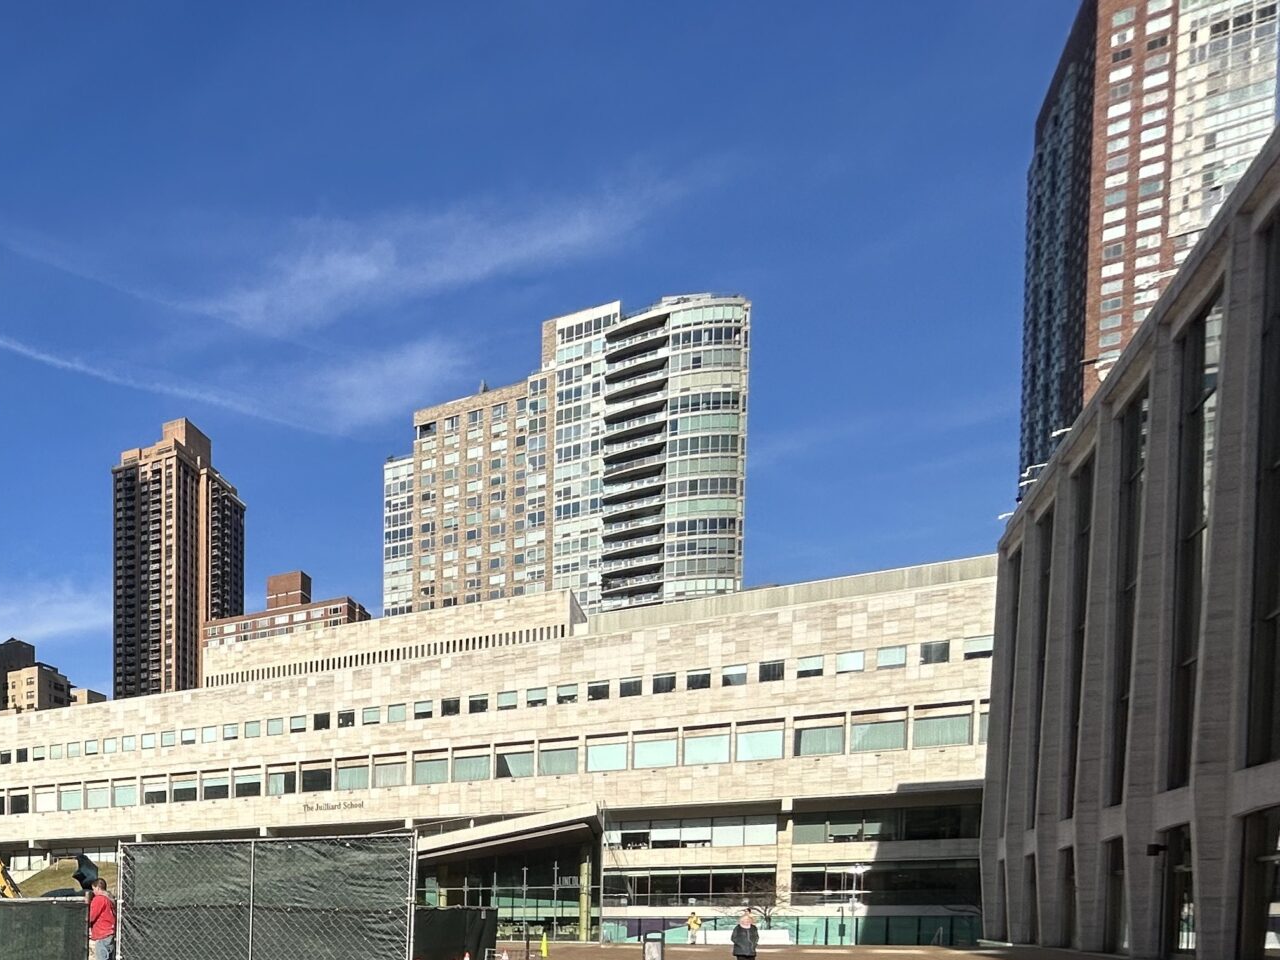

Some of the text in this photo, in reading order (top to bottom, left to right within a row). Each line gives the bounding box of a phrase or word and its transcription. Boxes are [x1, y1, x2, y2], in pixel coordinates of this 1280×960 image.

[303, 800, 364, 812] The Juilliard School
